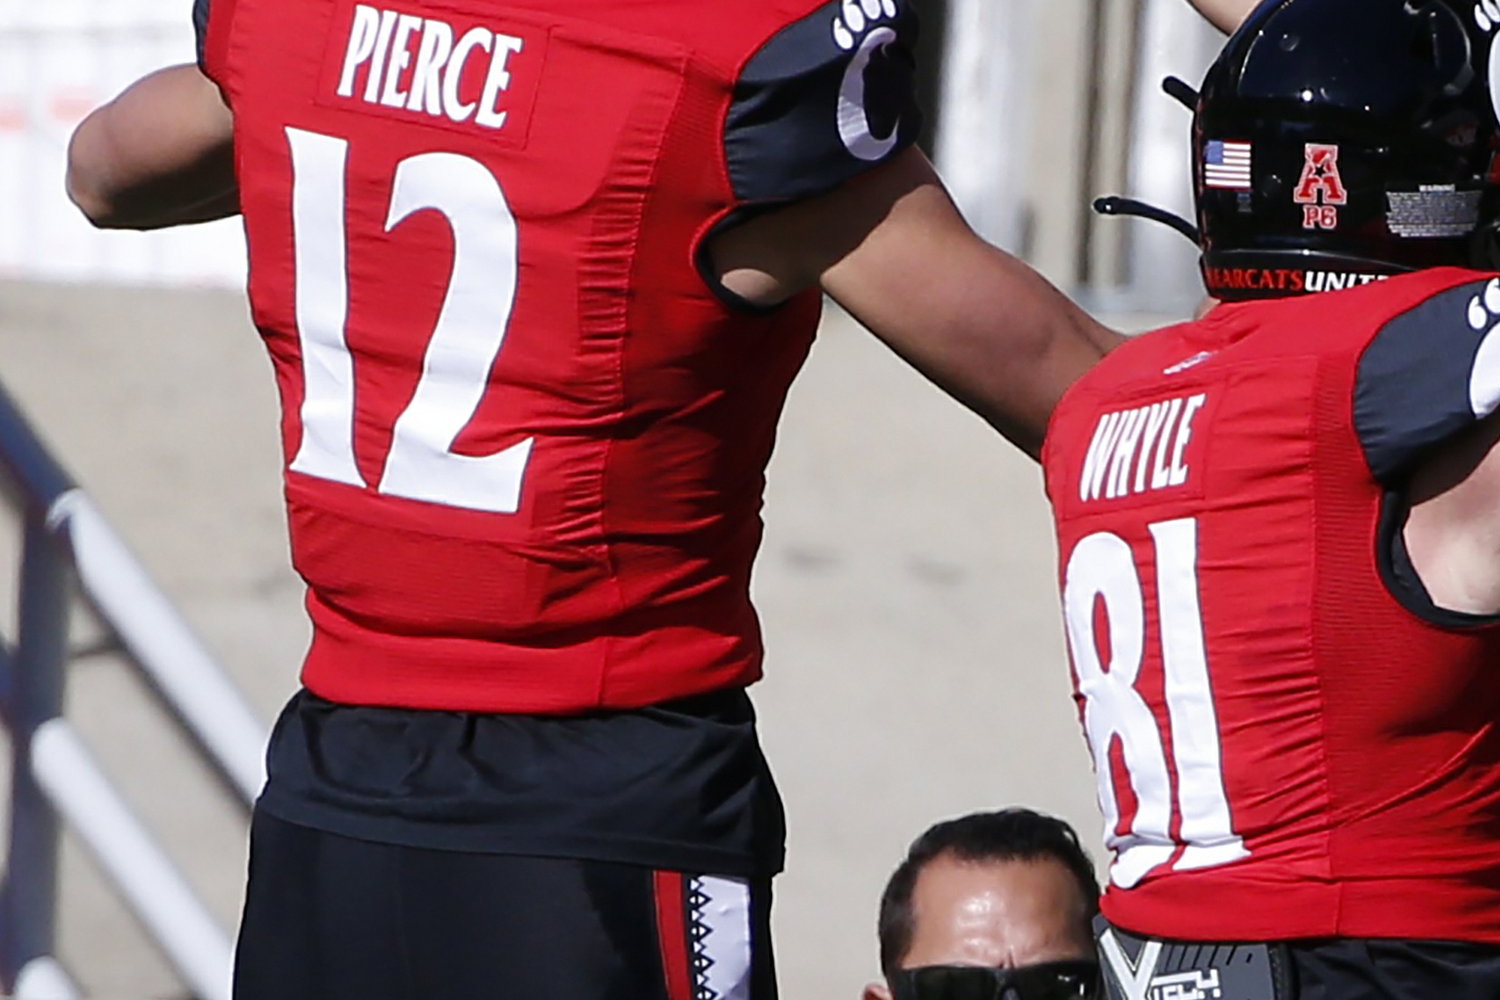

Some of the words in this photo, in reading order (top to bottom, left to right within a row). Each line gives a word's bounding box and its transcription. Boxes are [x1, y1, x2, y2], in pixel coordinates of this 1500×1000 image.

[336, 3, 524, 129] PIERCE
[1302, 204, 1337, 229] P6
[283, 125, 534, 514] 12
[1304, 270, 1389, 292] UNIT
[1080, 393, 1206, 502] WHYLE
[1064, 517, 1252, 889] 81
